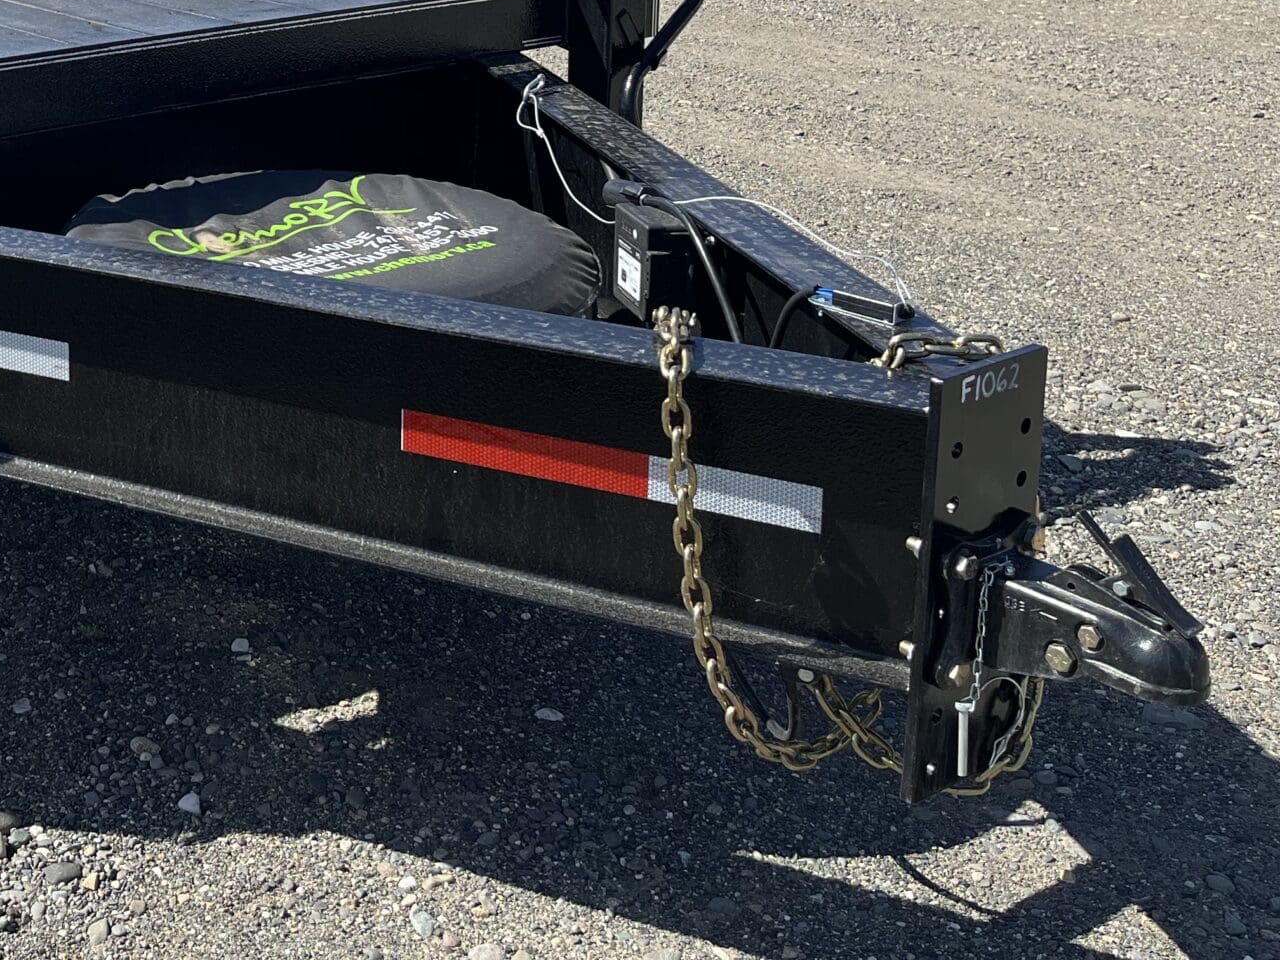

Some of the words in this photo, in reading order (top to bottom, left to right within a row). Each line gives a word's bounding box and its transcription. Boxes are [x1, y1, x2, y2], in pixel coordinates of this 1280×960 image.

[260, 251, 312, 266] MILE
[308, 231, 376, 253] HOUSE
[270, 251, 361, 272] QUESNEL
[341, 244, 411, 266] HOUSE
[961, 362, 1020, 403] F1062
